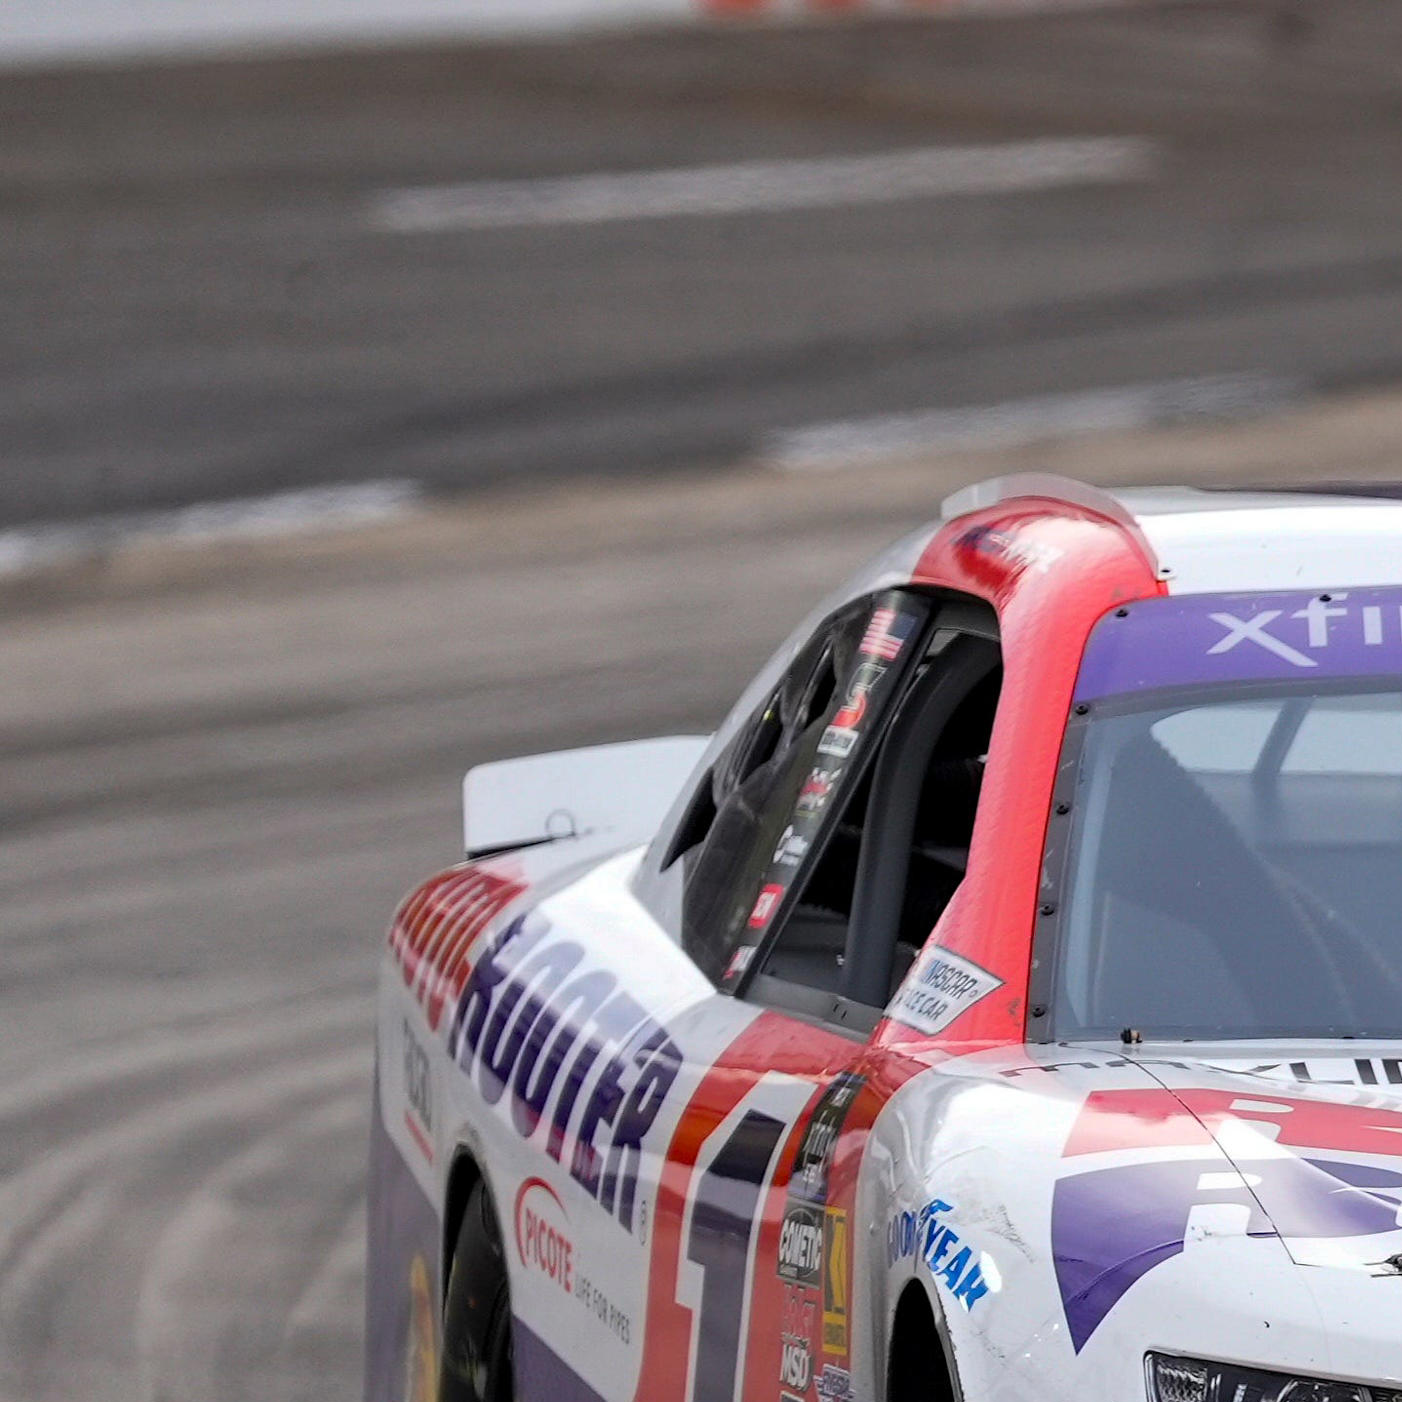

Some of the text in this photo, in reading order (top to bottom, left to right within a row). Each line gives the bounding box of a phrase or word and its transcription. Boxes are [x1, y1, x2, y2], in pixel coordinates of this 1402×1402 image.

[922, 960, 977, 1000] NASCAR
[525, 1207, 573, 1293] PICOTE
[778, 1218, 823, 1272] COMETIC
[779, 1343, 812, 1392] MSD
